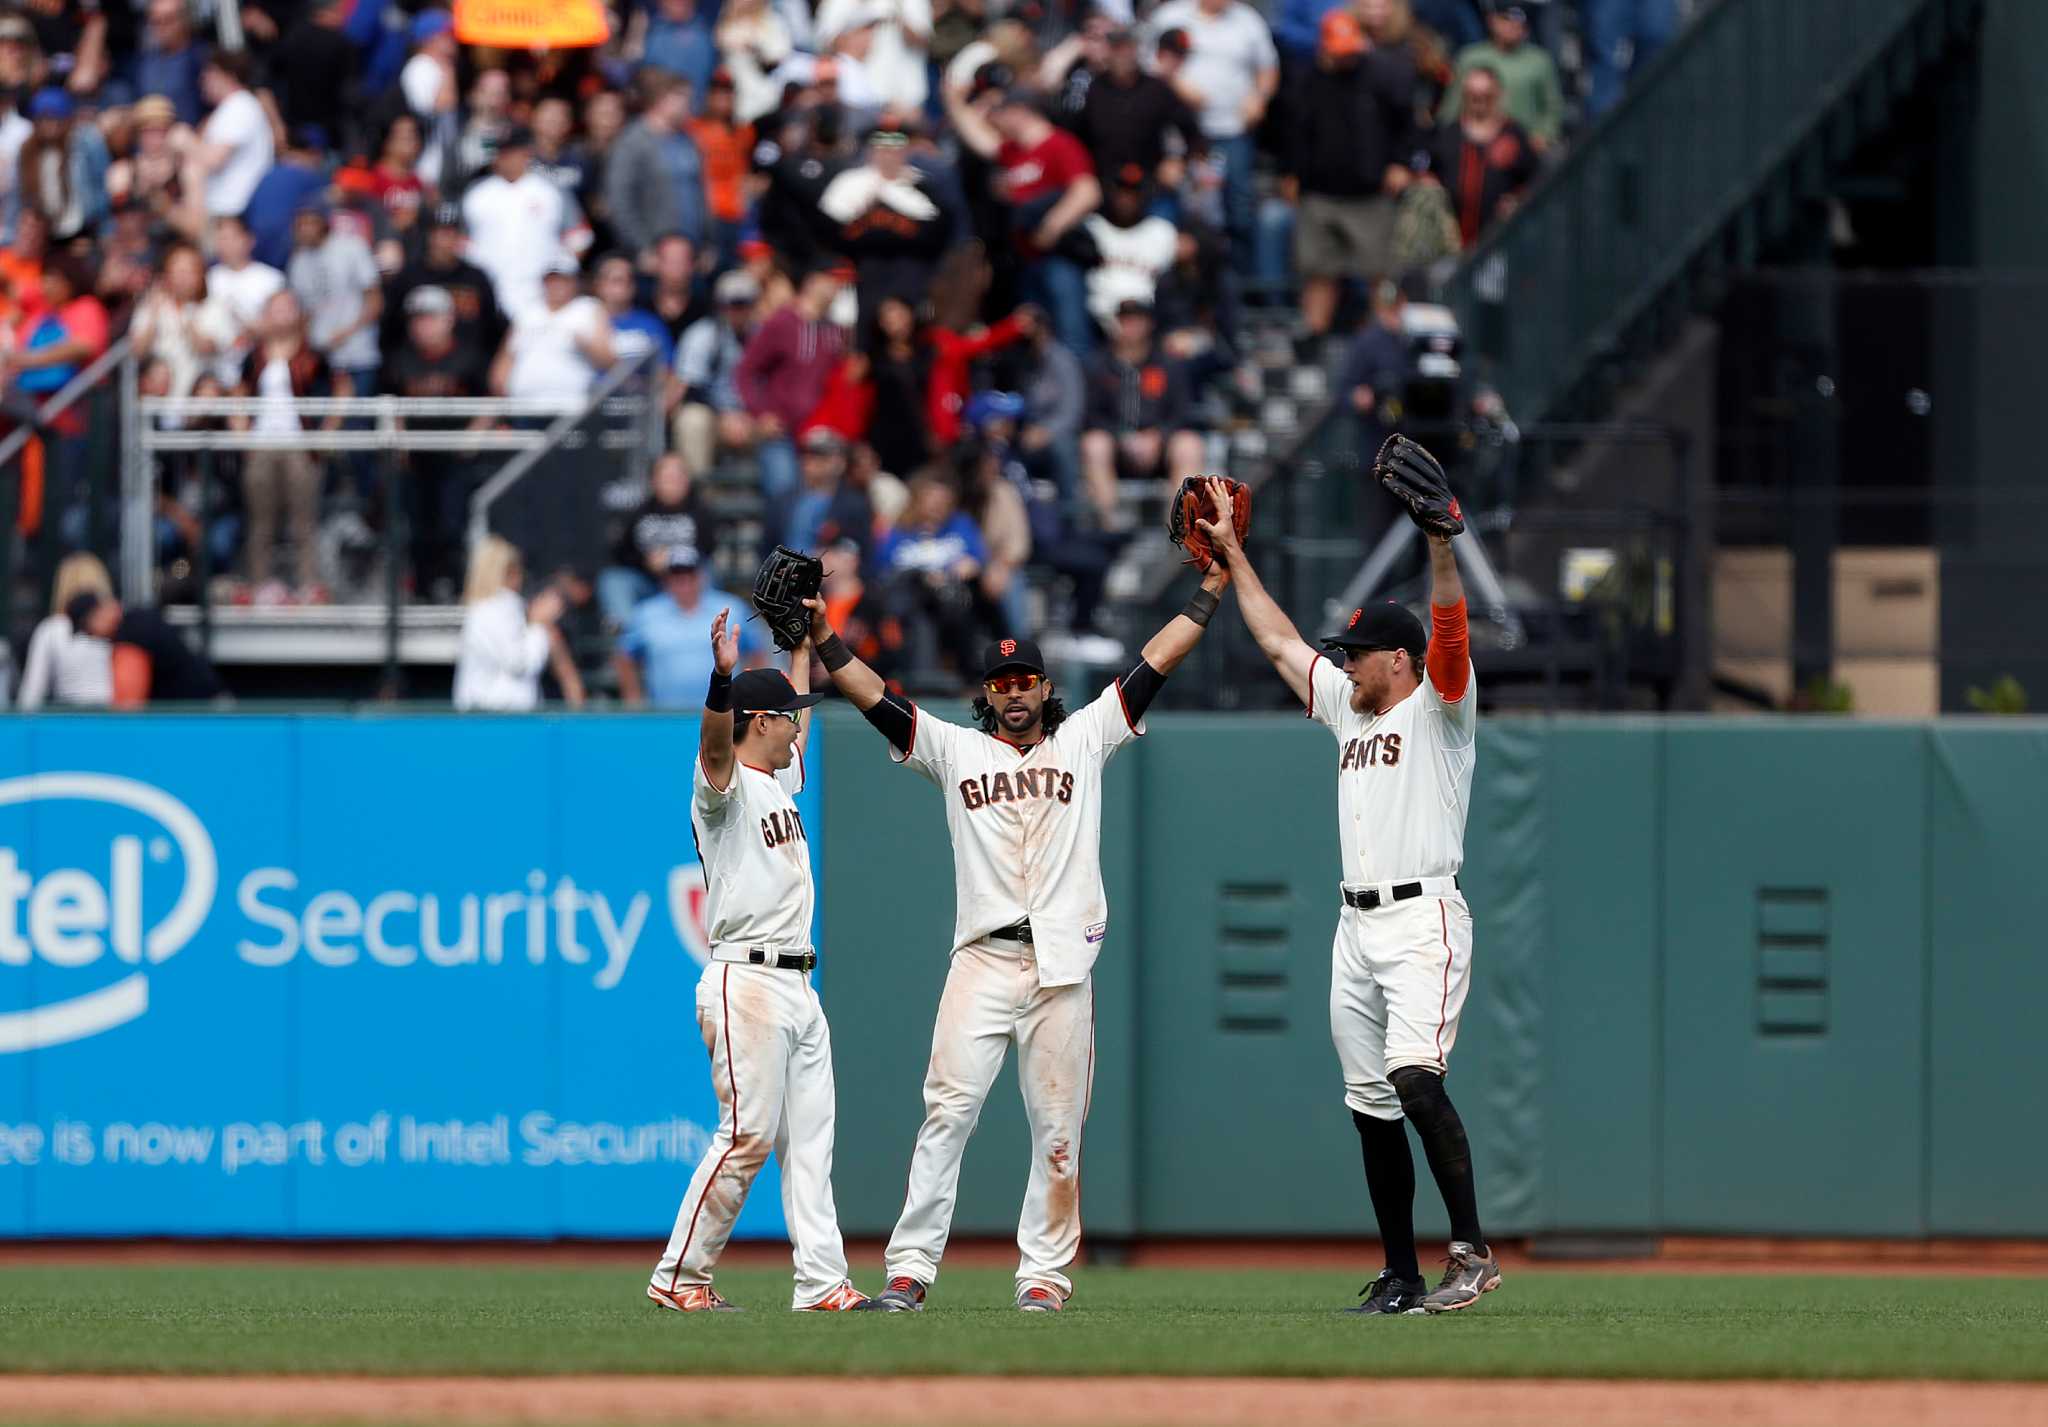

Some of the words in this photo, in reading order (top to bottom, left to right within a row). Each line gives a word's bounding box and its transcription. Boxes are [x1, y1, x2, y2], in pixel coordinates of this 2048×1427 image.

[1000, 639, 1017, 657] SF
[959, 767, 1075, 811] GIANTS
[236, 866, 652, 990] Security
[53, 1115, 96, 1167] is
[103, 1120, 215, 1167] now
[221, 1118, 328, 1176] part
[333, 1110, 392, 1168] of
[400, 1112, 512, 1168] Intel
